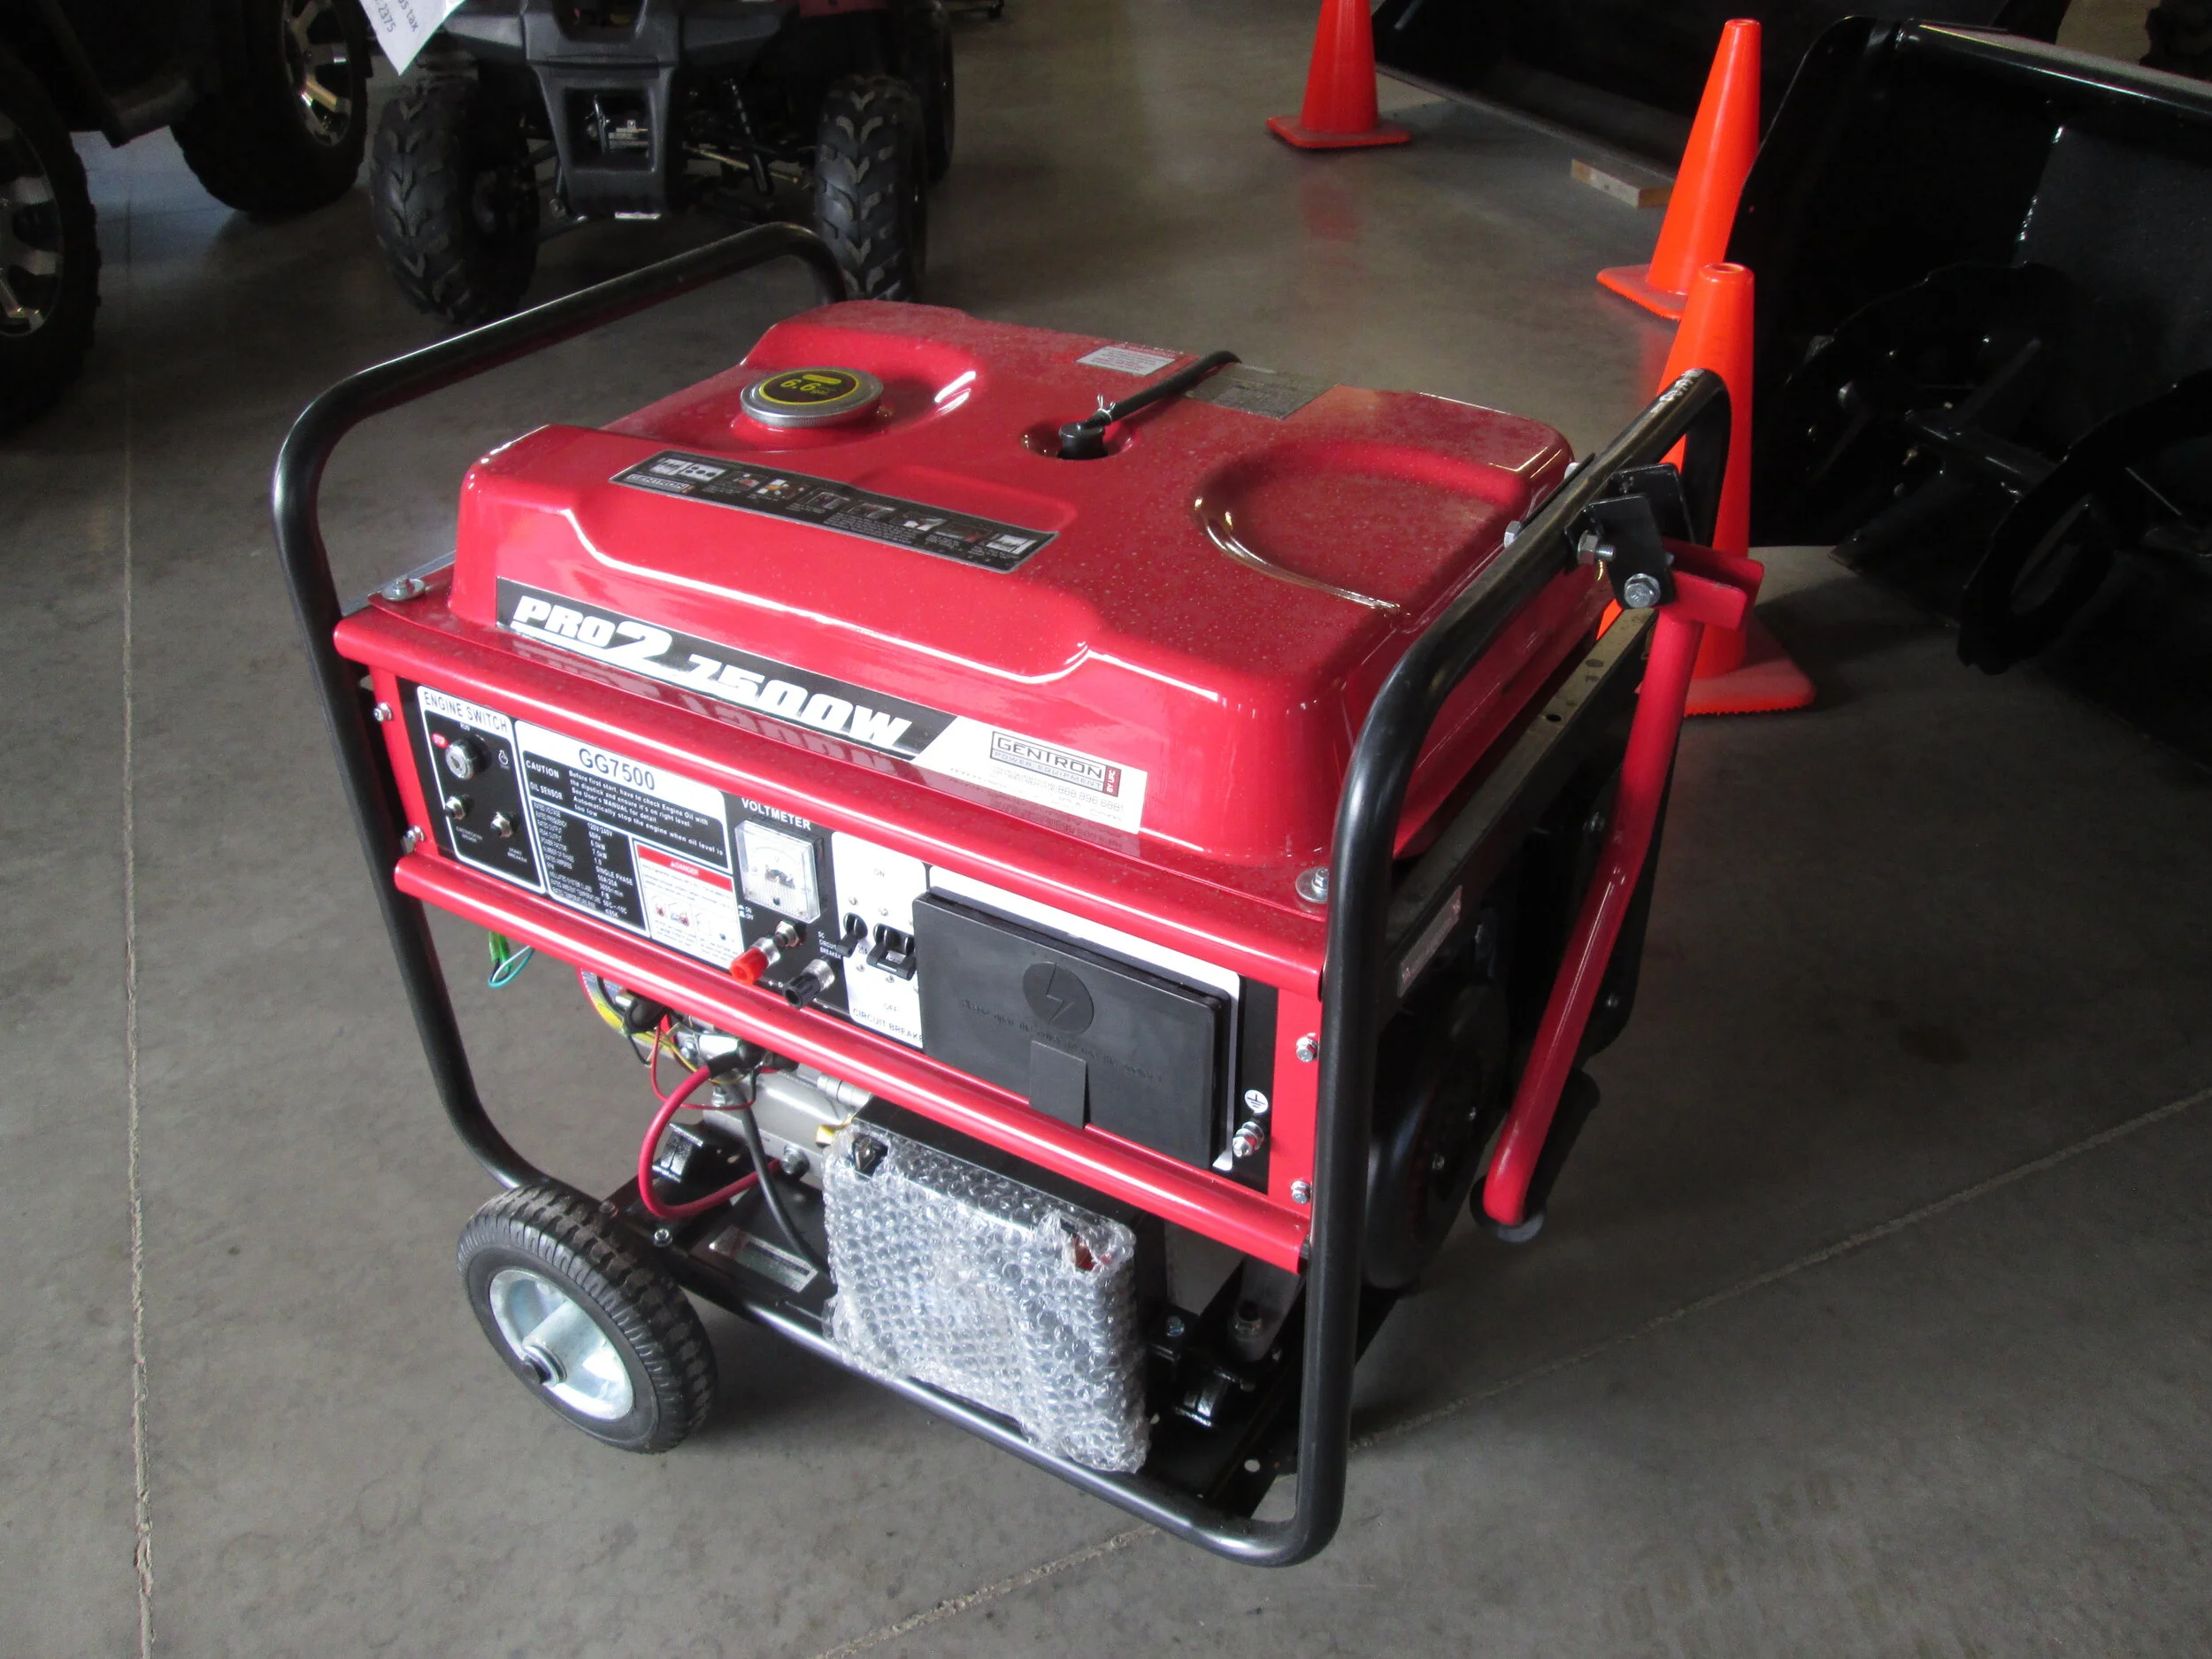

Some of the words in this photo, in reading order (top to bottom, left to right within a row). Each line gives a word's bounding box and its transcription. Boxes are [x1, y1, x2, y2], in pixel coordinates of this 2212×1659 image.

[406, 9, 419, 32] tax
[780, 379, 822, 391] 6.6
[424, 692, 463, 718] ENGINE
[466, 706, 508, 733] SWITCH
[684, 653, 913, 750] 7500W
[526, 760, 560, 779] CAUTION
[579, 748, 655, 790] GG7500
[994, 751, 1033, 767] POWER
[1038, 764, 1102, 791] EQUIPMENT
[997, 736, 1102, 779] GENTRON
[529, 781, 540, 792] OIL
[540, 783, 564, 801] SENSOR
[569, 770, 588, 782] Before
[588, 778, 603, 788] first
[619, 788, 634, 799] have
[642, 797, 661, 809] check
[662, 803, 683, 818] Engine
[684, 811, 694, 820] Oil
[695, 816, 709, 826] with
[570, 779, 580, 787] the
[580, 783, 603, 796] dipstick
[605, 791, 616, 800] and
[617, 796, 638, 809] ensure
[659, 812, 674, 822] right
[603, 796, 628, 813] MANUAL
[629, 806, 638, 816] for
[572, 795, 616, 818] Automatically
[617, 812, 633, 824] stop
[633, 818, 644, 826] the
[645, 823, 668, 835] engine
[669, 832, 687, 843] when
[687, 838, 697, 847] oil
[698, 841, 715, 853] level
[586, 807, 598, 818] low
[741, 797, 811, 830] VOLTMETER
[853, 1008, 886, 1027] CIRCUIT
